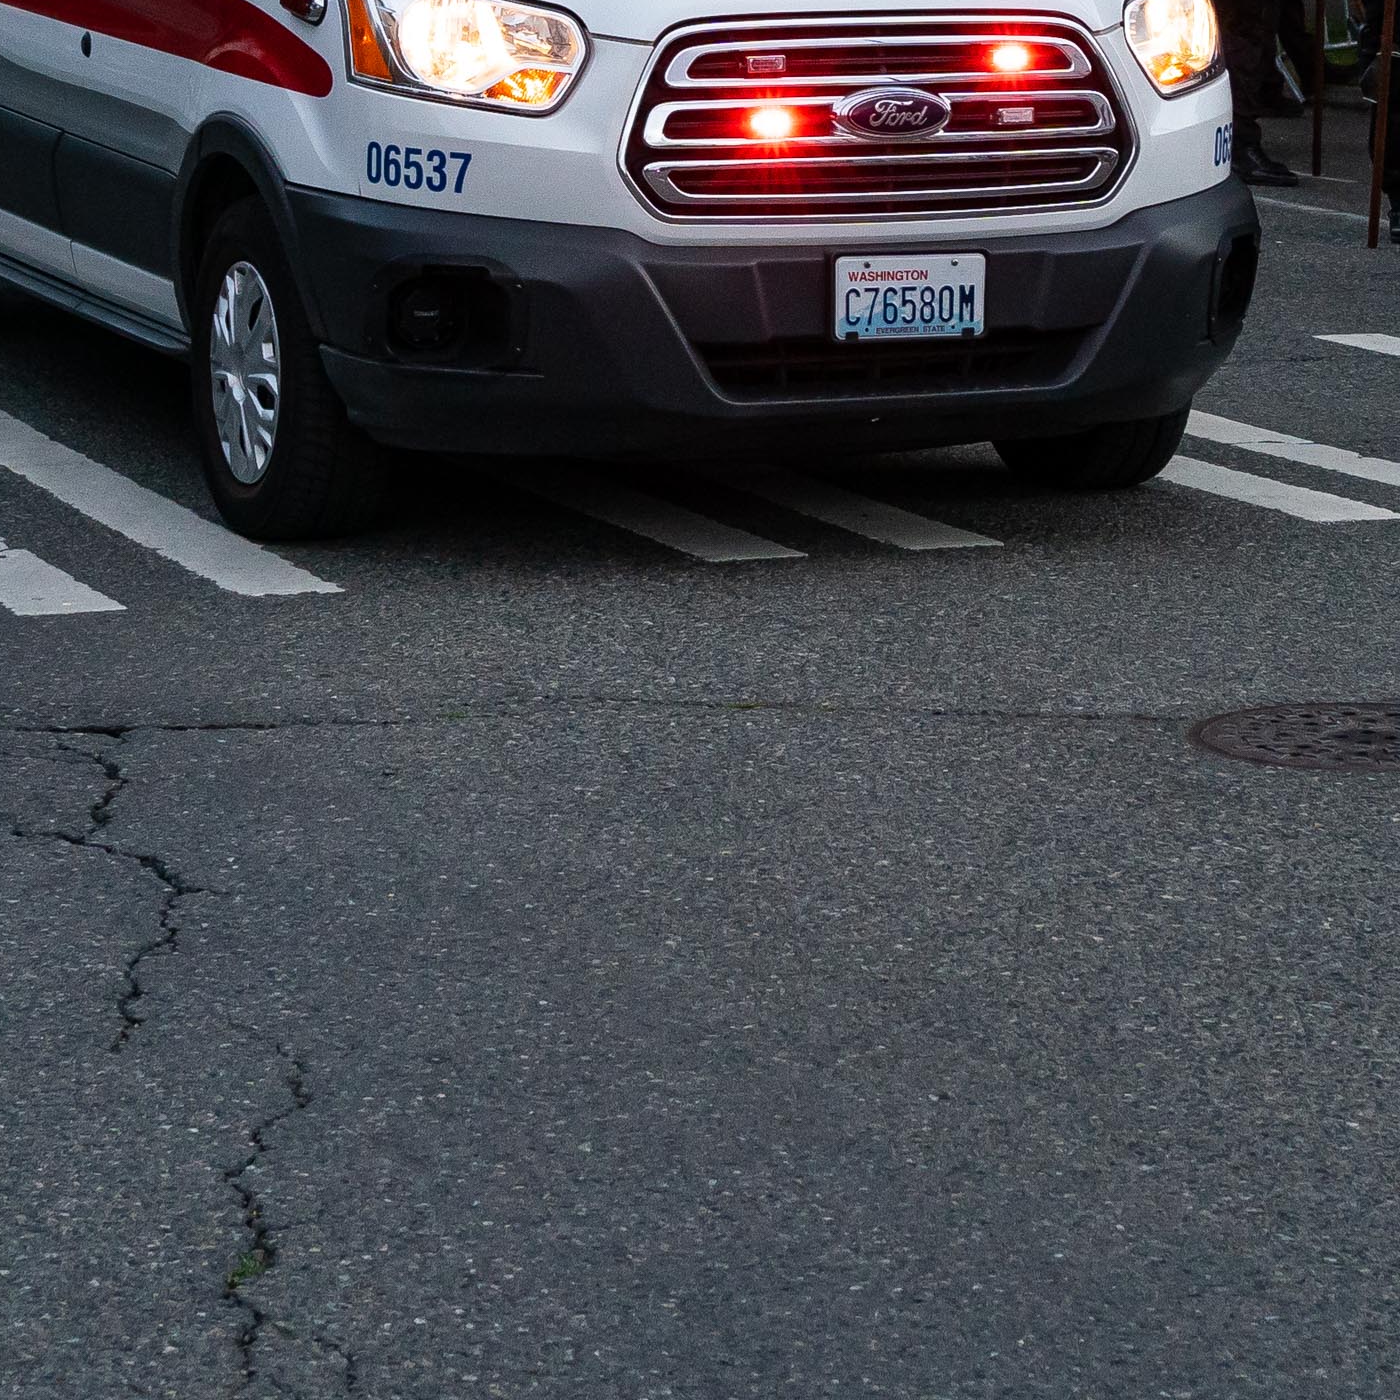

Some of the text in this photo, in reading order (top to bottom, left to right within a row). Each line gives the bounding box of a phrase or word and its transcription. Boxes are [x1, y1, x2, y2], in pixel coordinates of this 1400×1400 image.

[869, 99, 928, 127] Ford
[366, 141, 472, 194] 06537
[848, 270, 929, 282] WASHINGTON
[845, 284, 976, 326] C76580M
[876, 325, 946, 335] EVERGREEN STATE
